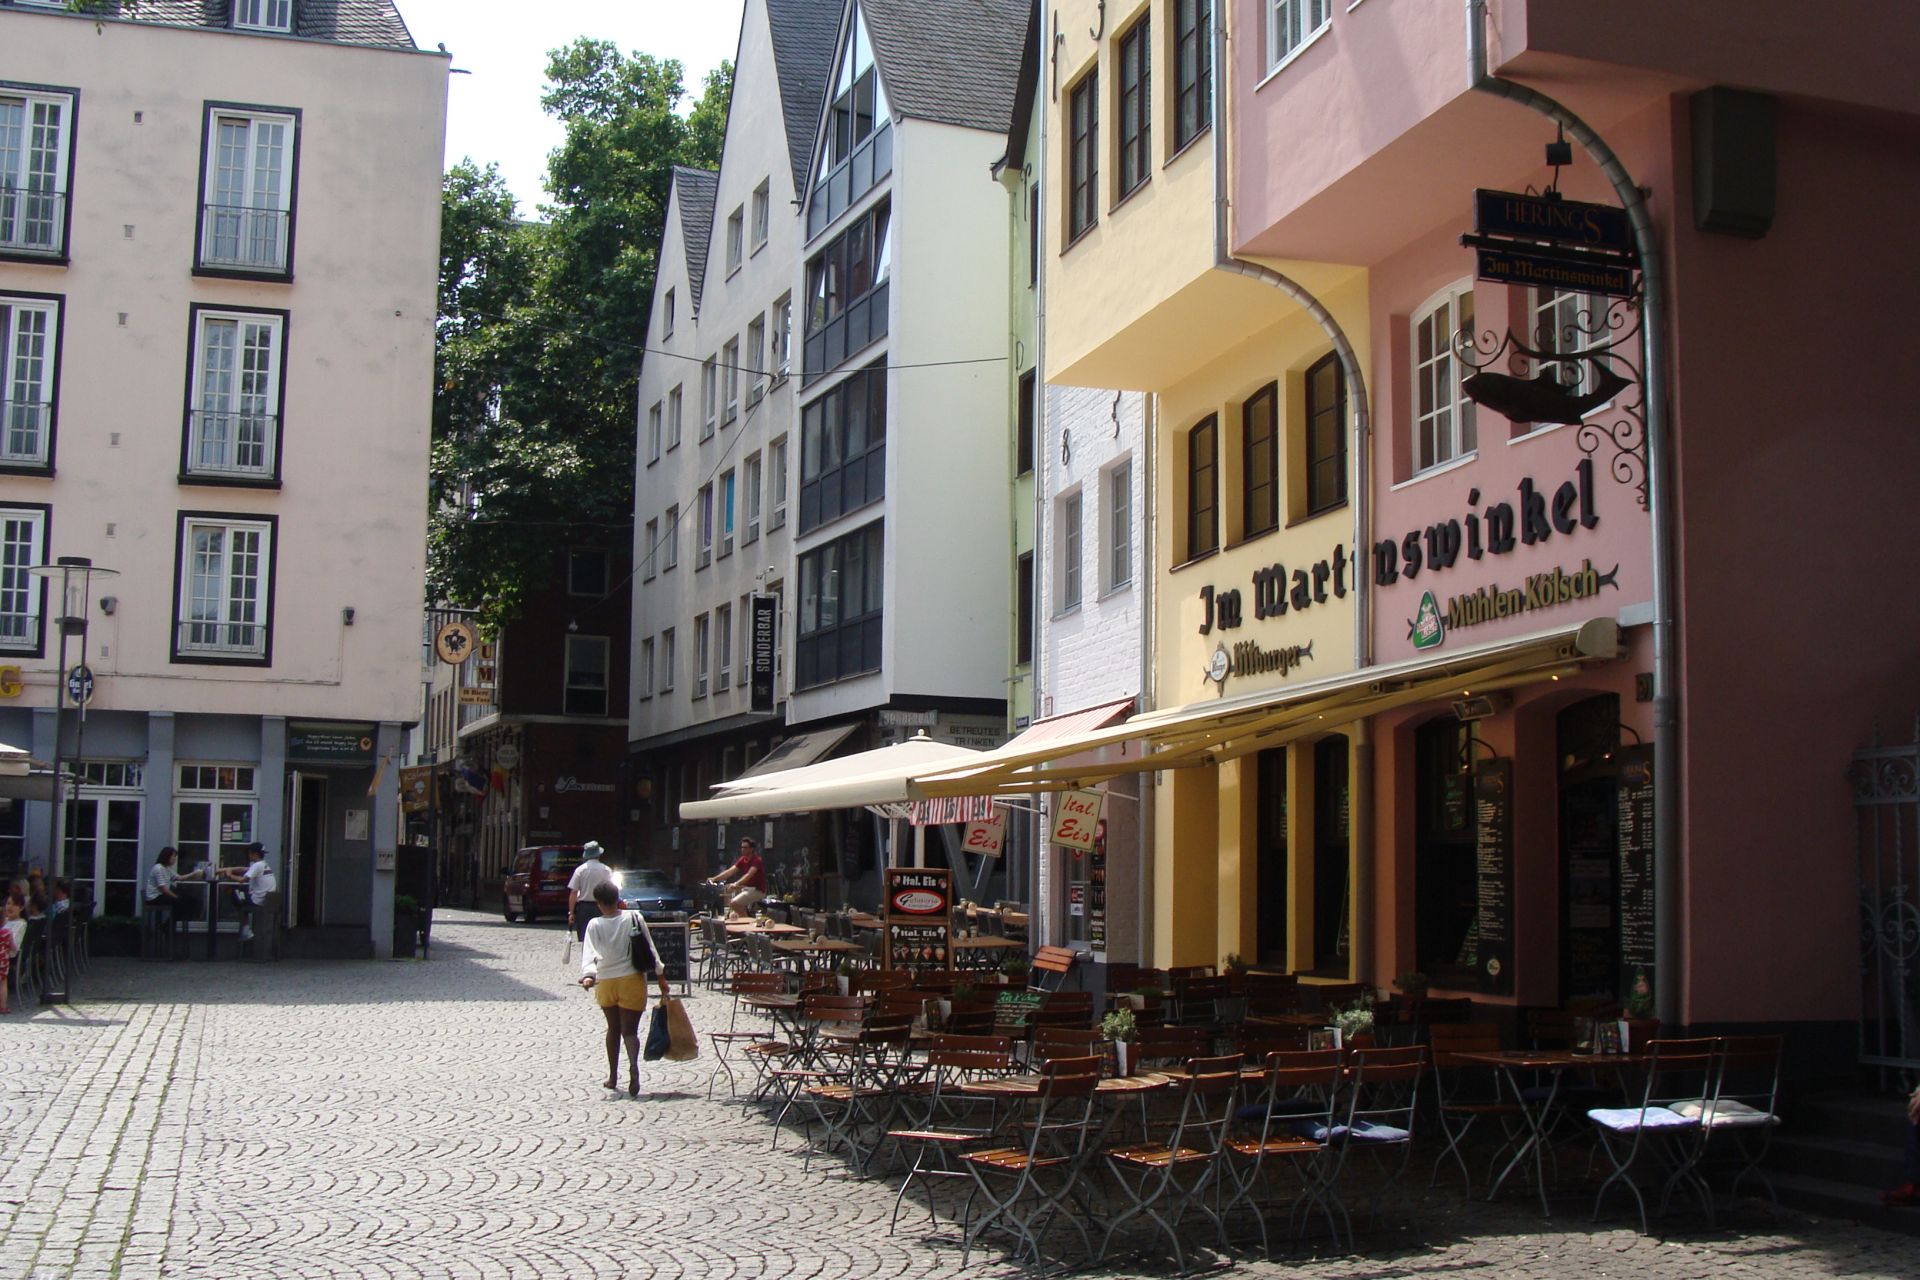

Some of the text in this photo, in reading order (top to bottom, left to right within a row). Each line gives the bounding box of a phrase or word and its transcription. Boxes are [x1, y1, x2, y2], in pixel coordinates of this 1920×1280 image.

[1486, 255, 1624, 289] Im Martinswinkel
[1198, 458, 1599, 636] Im Martnswinkel
[1447, 583, 1520, 631] Mühlen
[1524, 558, 1600, 612] Kölsch
[756, 608, 771, 673] SONDERBAR
[950, 726, 1000, 736] BETREUTES
[954, 737, 995, 746] TRINKEN
[1063, 794, 1095, 817] Ital.
[968, 828, 998, 849] Eis
[1057, 818, 1090, 843] Eis
[923, 876, 937, 886] Eis
